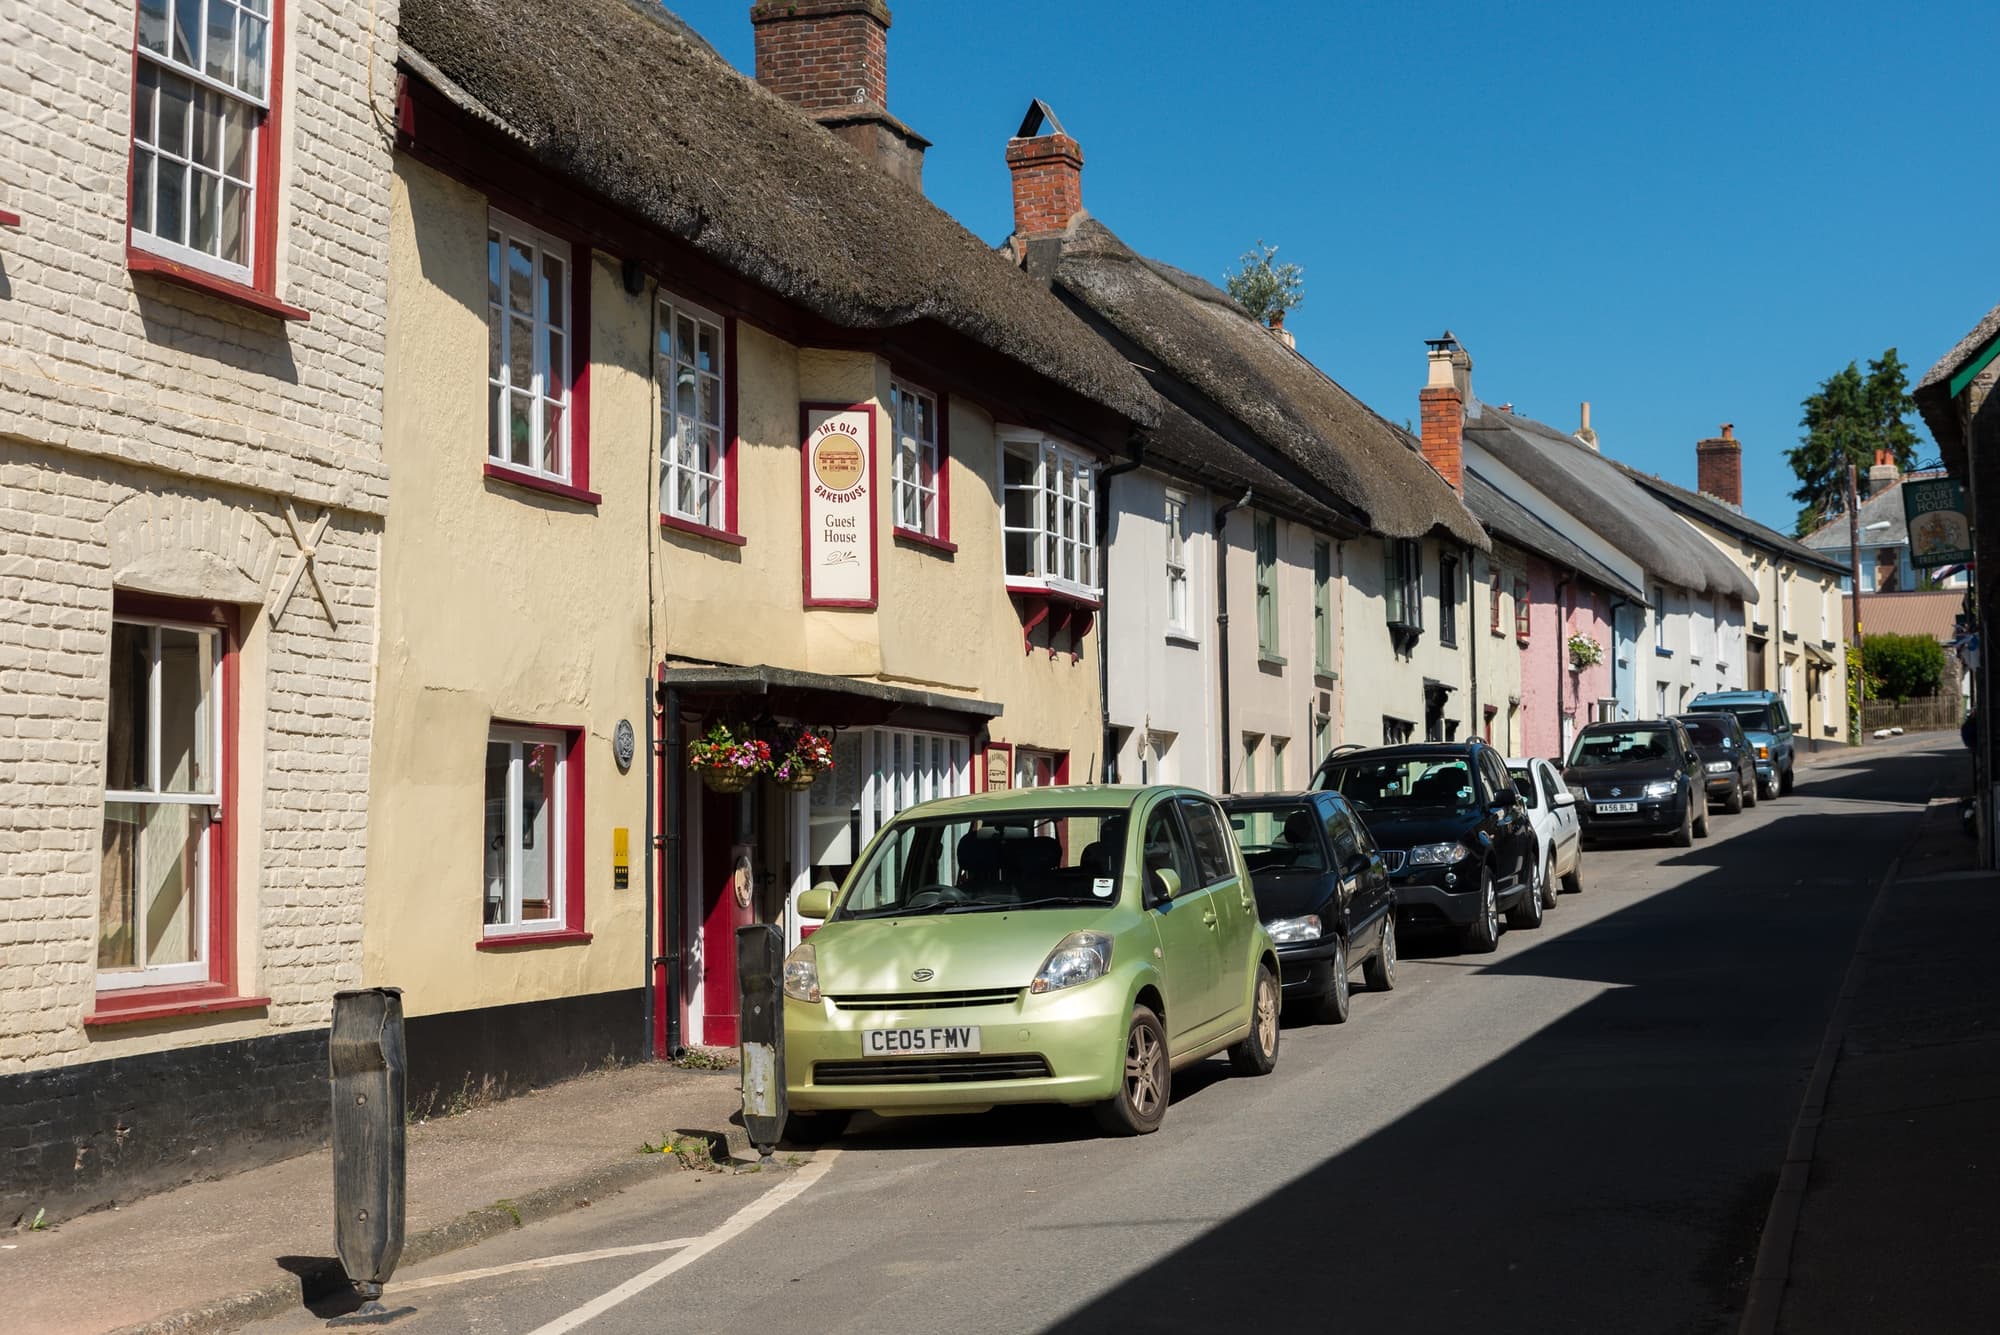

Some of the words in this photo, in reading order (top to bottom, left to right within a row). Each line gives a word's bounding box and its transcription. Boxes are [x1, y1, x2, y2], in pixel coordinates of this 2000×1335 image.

[817, 422, 836, 436] THE
[840, 422, 858, 436] OLD
[814, 485, 866, 503] BAKEHOUSE
[1915, 488, 1953, 502] COURT
[1917, 499, 1955, 512] HOUSE
[825, 514, 856, 528] Guest
[824, 529, 857, 543] House
[1919, 555, 1936, 564] FREE
[1937, 551, 1964, 561] HOUSE
[871, 1029, 926, 1051] CE05
[931, 1027, 971, 1049] FMV
